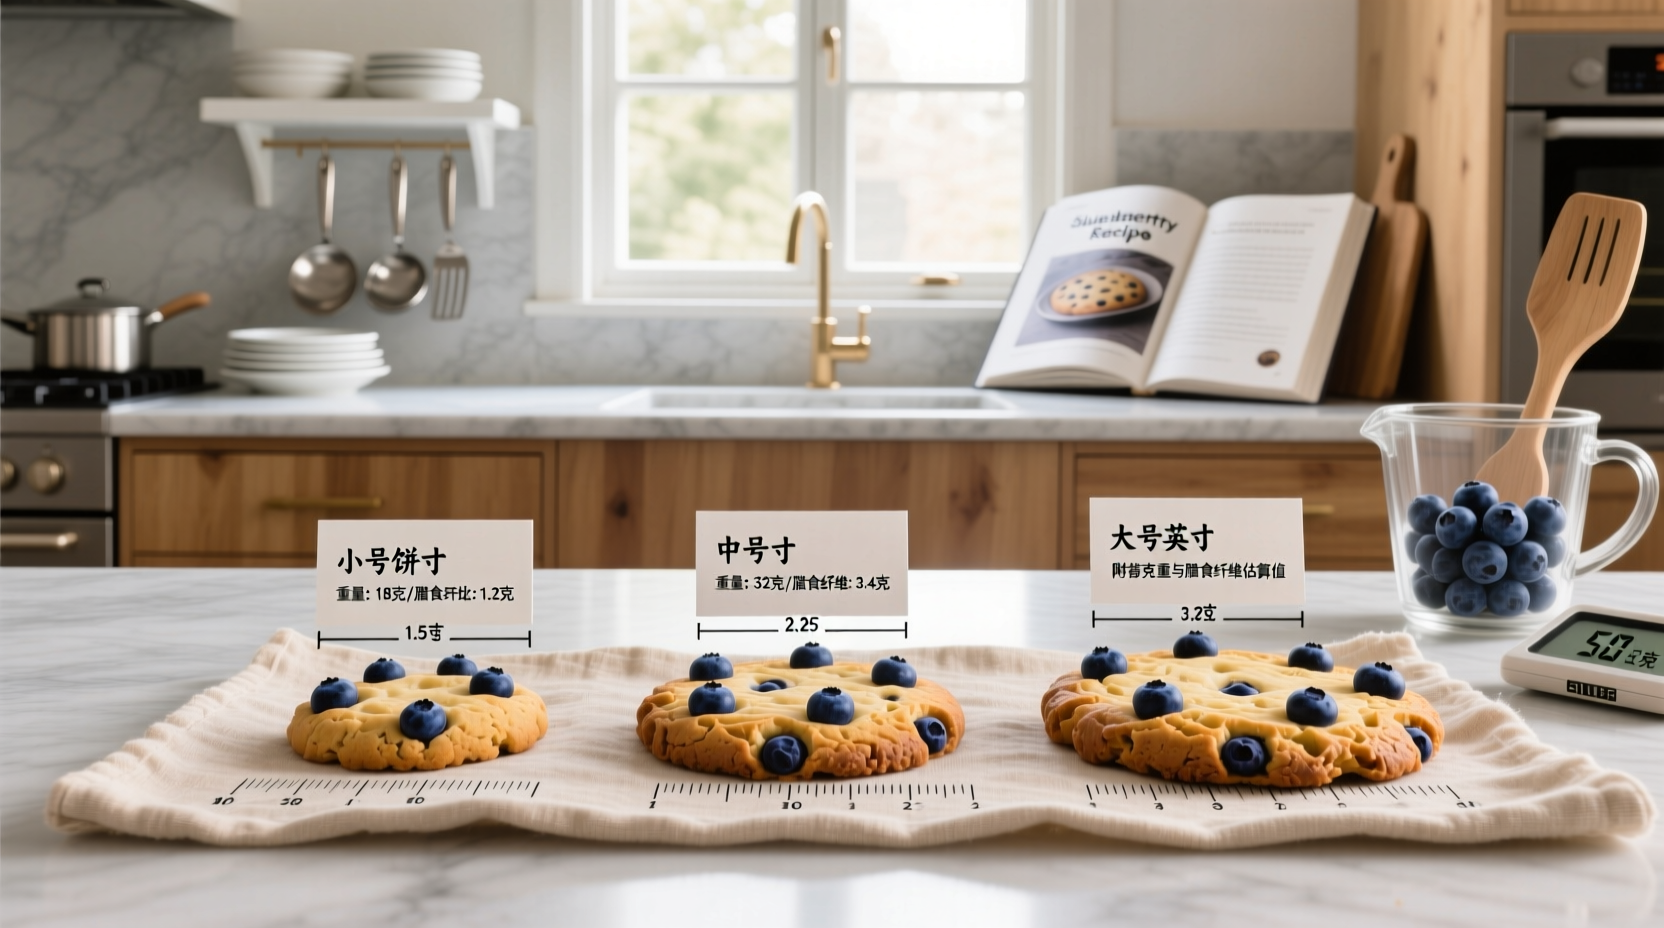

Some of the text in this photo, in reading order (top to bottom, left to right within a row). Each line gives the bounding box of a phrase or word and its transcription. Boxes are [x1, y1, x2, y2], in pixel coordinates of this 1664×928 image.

[1110, 523, 1214, 552] 大号英寸
[337, 547, 447, 576] 小号饼寸
[717, 535, 796, 565] 中号寸
[480, 585, 515, 601] 1.2克
[856, 573, 891, 590] 3.4克
[785, 616, 819, 633] 2.25
